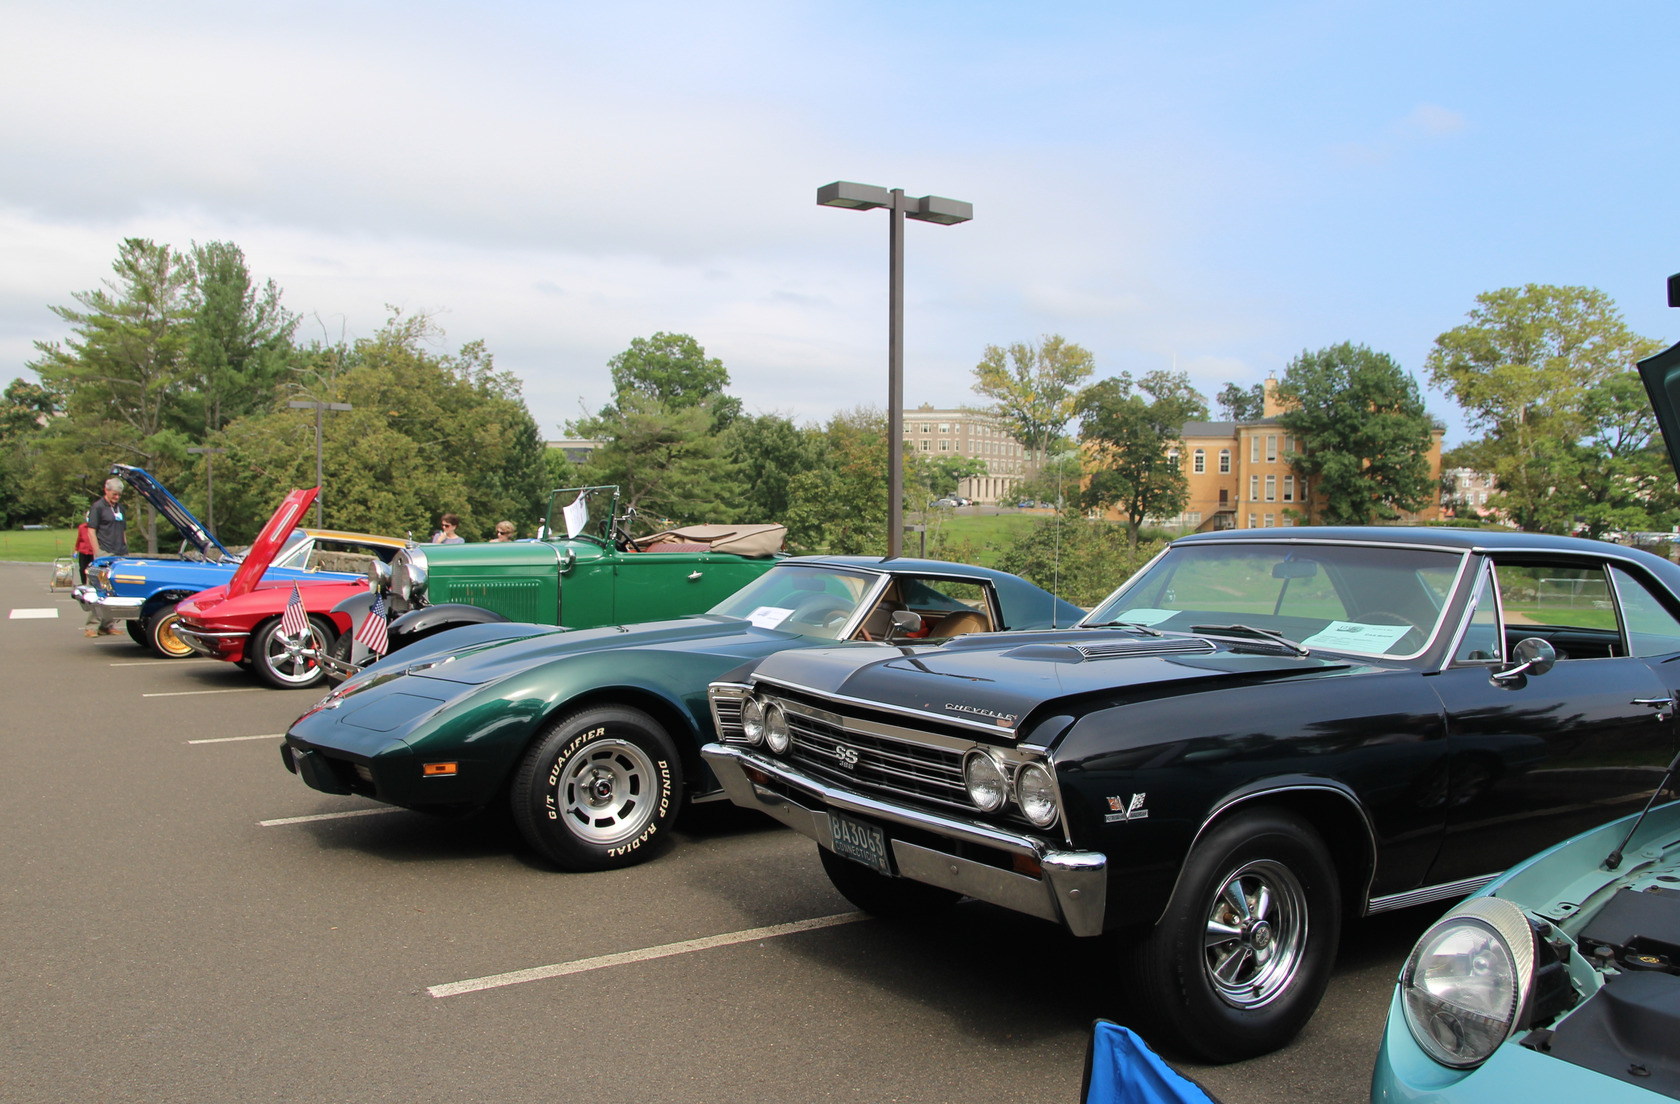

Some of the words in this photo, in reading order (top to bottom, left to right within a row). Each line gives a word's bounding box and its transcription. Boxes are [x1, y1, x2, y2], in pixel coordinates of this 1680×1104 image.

[944, 703, 1015, 721] CHEVELLE
[548, 727, 605, 786] QUALIFIER
[836, 745, 858, 764] SS
[658, 760, 673, 818] DUNLOP
[546, 795, 557, 820] G/T
[607, 822, 657, 857] RADIAL
